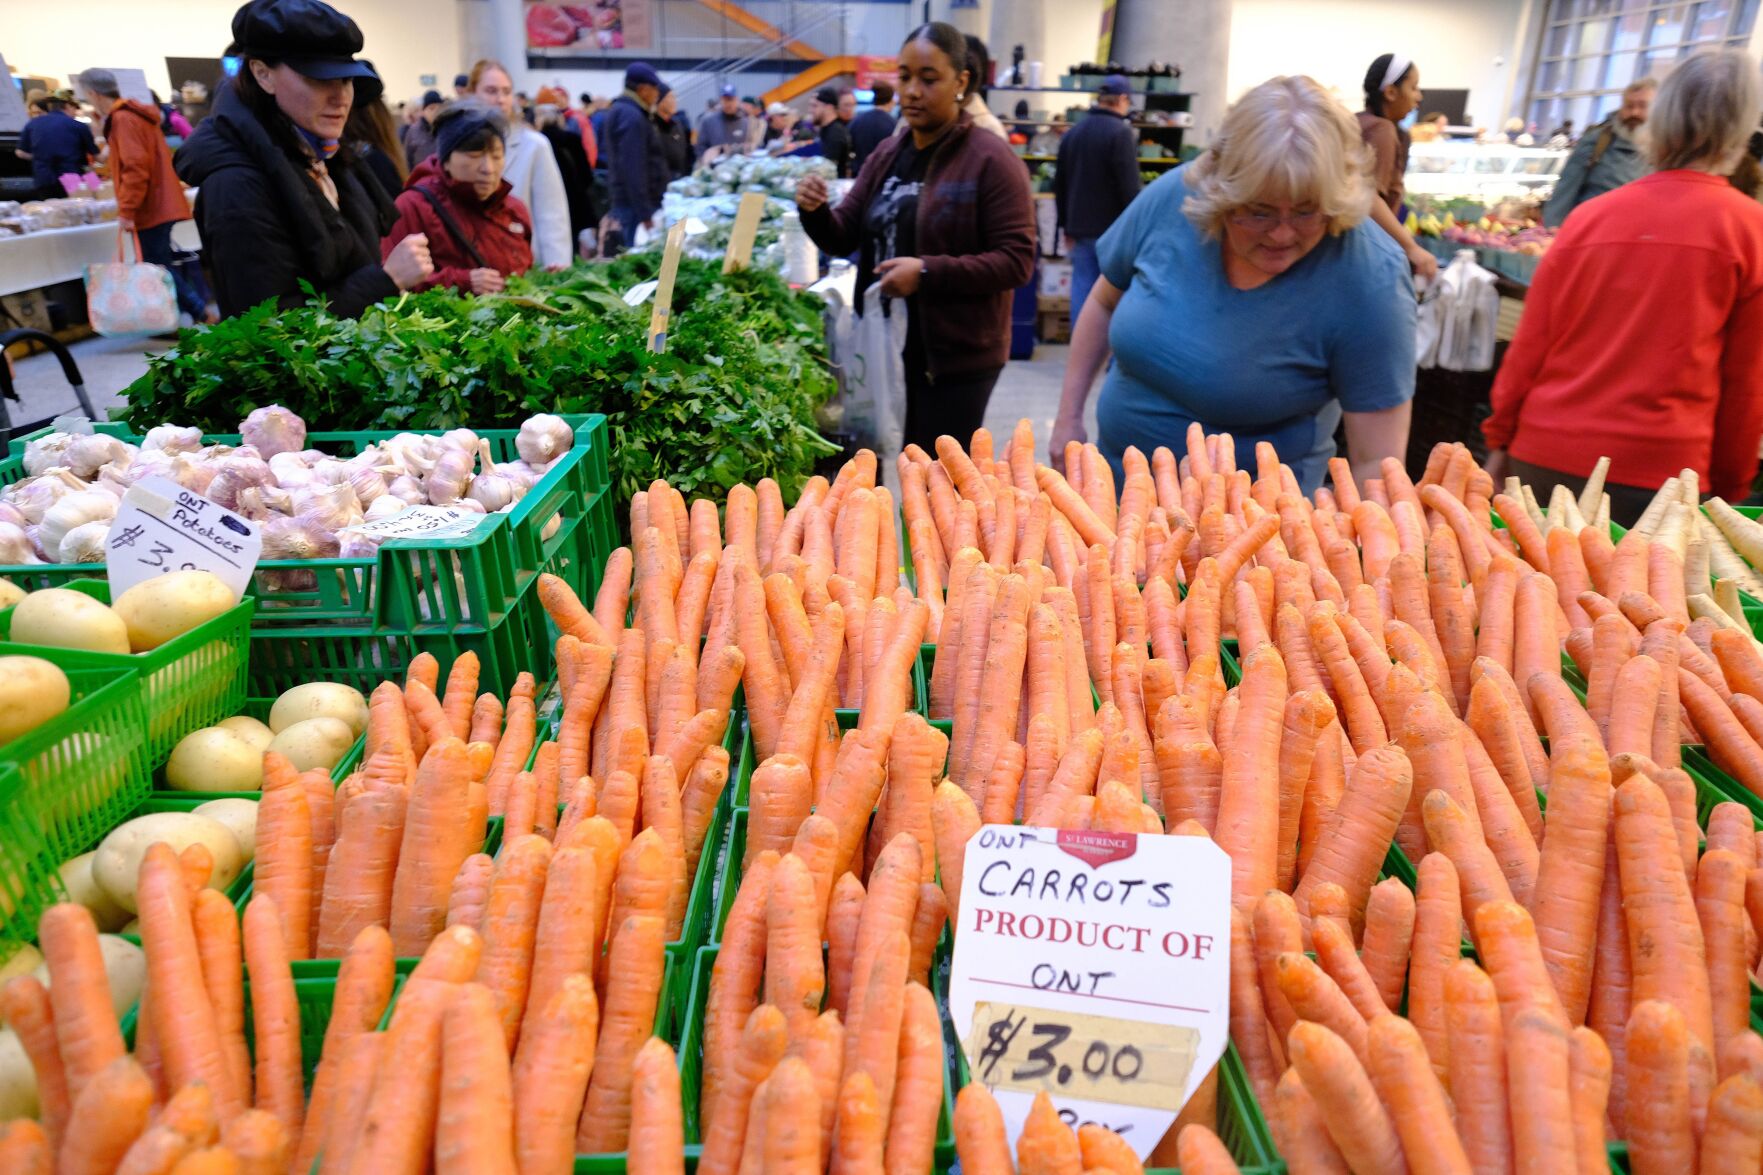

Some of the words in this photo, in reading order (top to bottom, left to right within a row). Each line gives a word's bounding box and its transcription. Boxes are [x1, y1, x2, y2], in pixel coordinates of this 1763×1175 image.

[179, 491, 210, 511] ONT
[173, 509, 244, 554] Potatoes
[978, 829, 1038, 850] ONT
[1076, 835, 1128, 849] LAWRENCE
[978, 860, 1173, 908] CARROTS
[973, 908, 1151, 953] PRODUCT
[1162, 931, 1214, 960] OF
[1031, 963, 1116, 995] ONT
[978, 1008, 1143, 1085] $3.00
